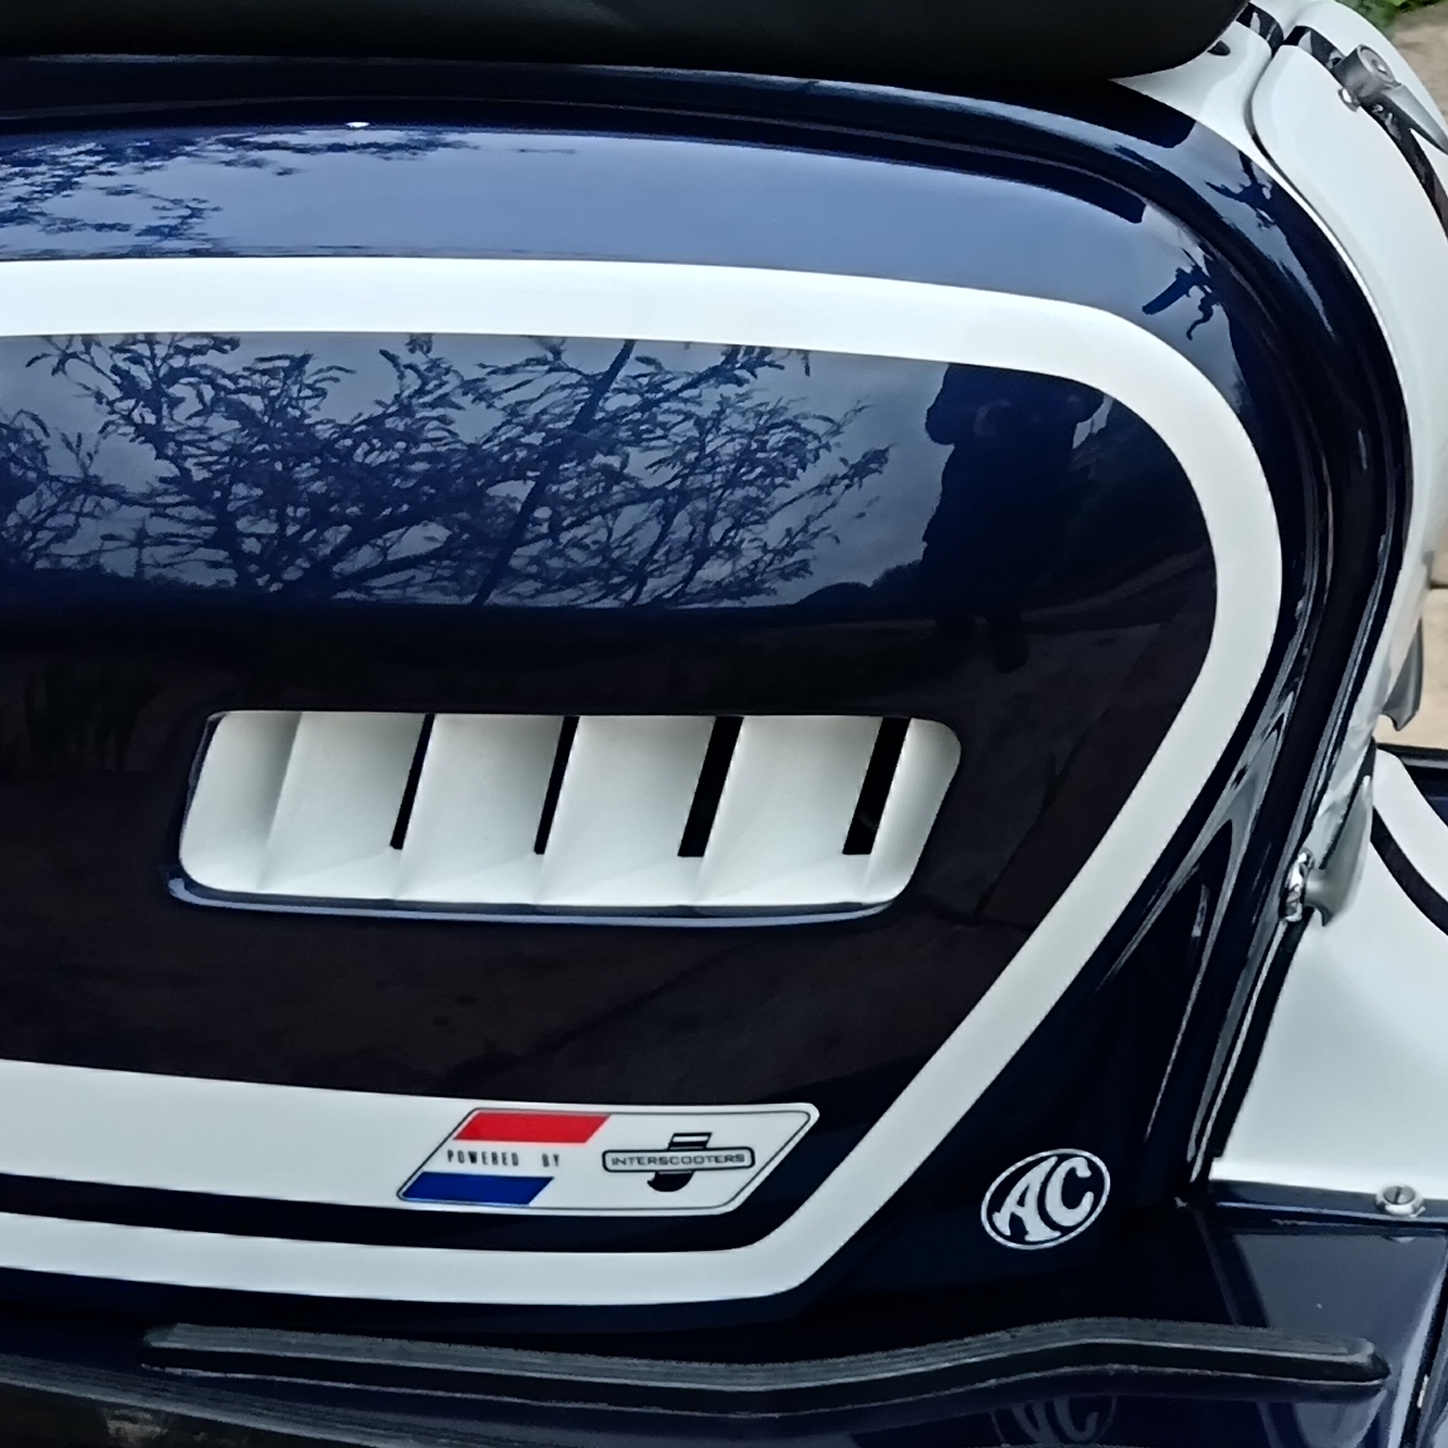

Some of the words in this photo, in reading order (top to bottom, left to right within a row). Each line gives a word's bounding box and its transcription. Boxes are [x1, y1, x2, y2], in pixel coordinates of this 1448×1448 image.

[447, 1149, 520, 1167] POWERED
[542, 1153, 561, 1168] BY
[611, 1154, 746, 1166] INTERSCOOTERS
[992, 1156, 1095, 1242] AC
